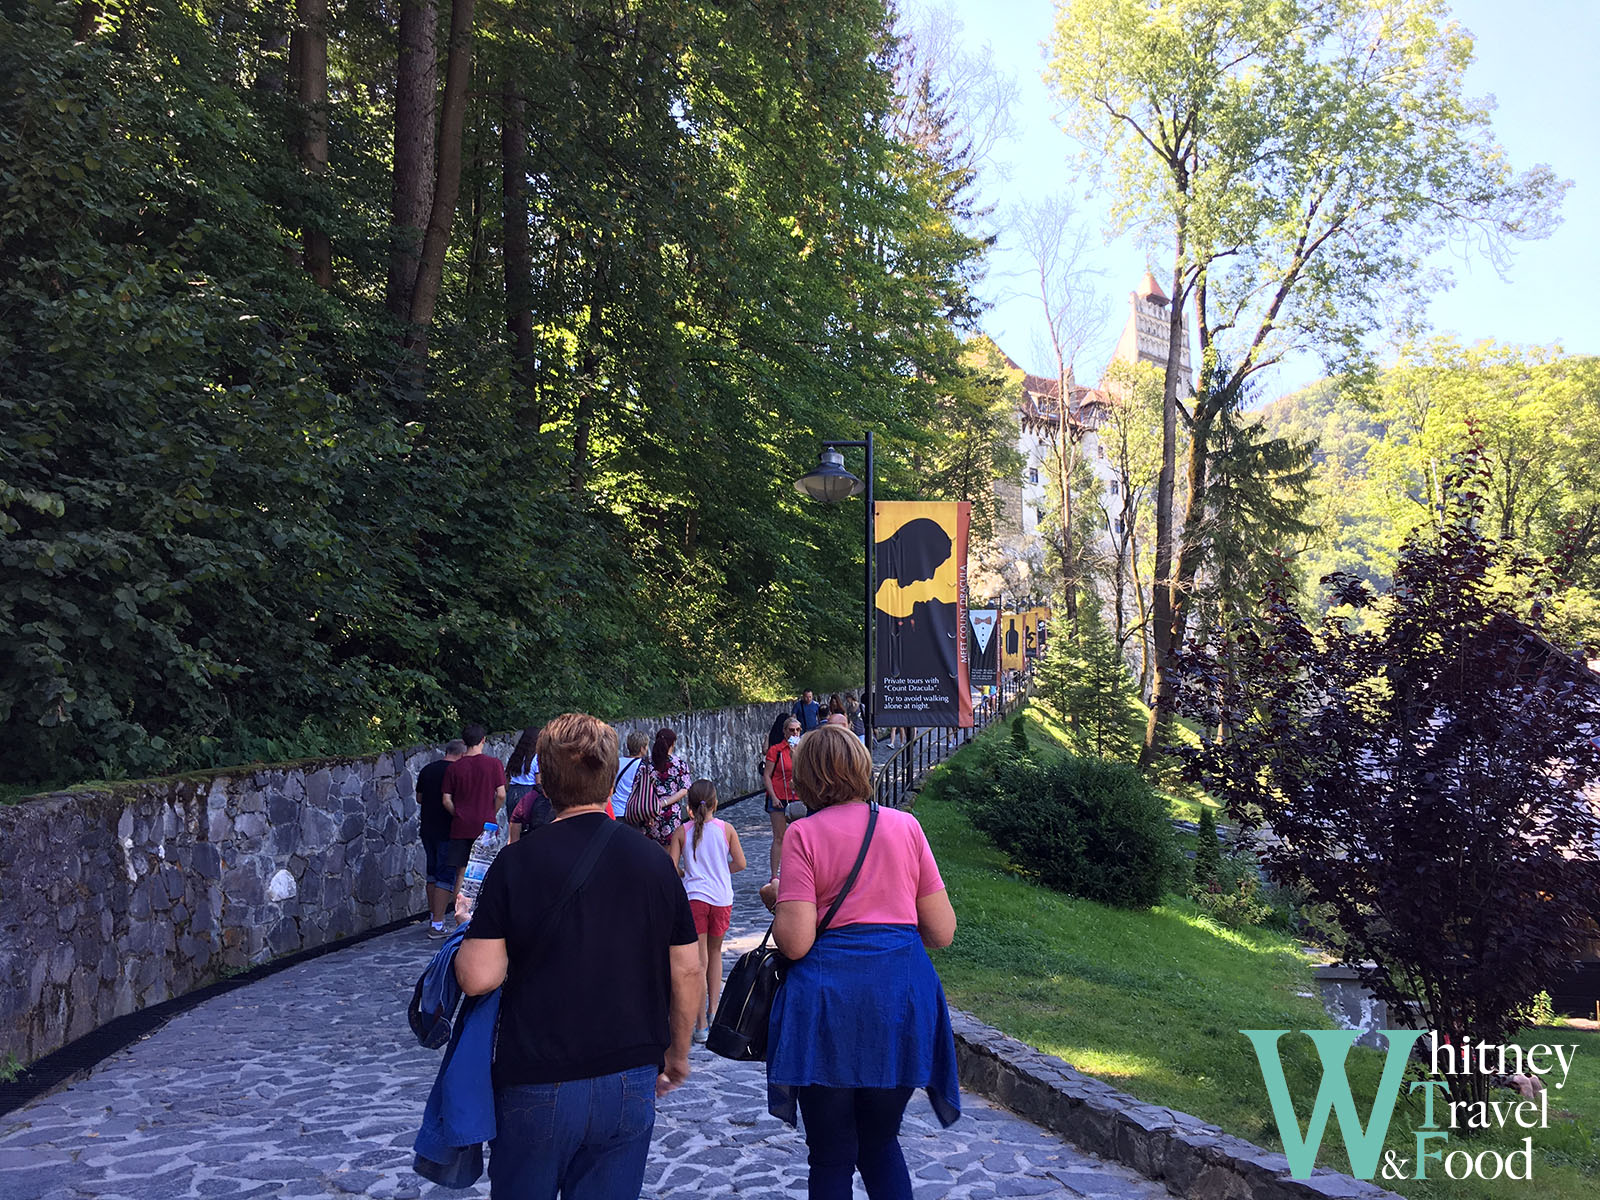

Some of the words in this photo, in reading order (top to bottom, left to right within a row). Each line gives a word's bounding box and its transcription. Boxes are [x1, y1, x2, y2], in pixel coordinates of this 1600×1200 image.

[959, 565, 968, 606] DRACULA
[959, 610, 968, 640] COUNT
[960, 642, 968, 663] MEET
[884, 695, 894, 703] Try
[923, 695, 949, 703] walking
[911, 703, 930, 711] night.
